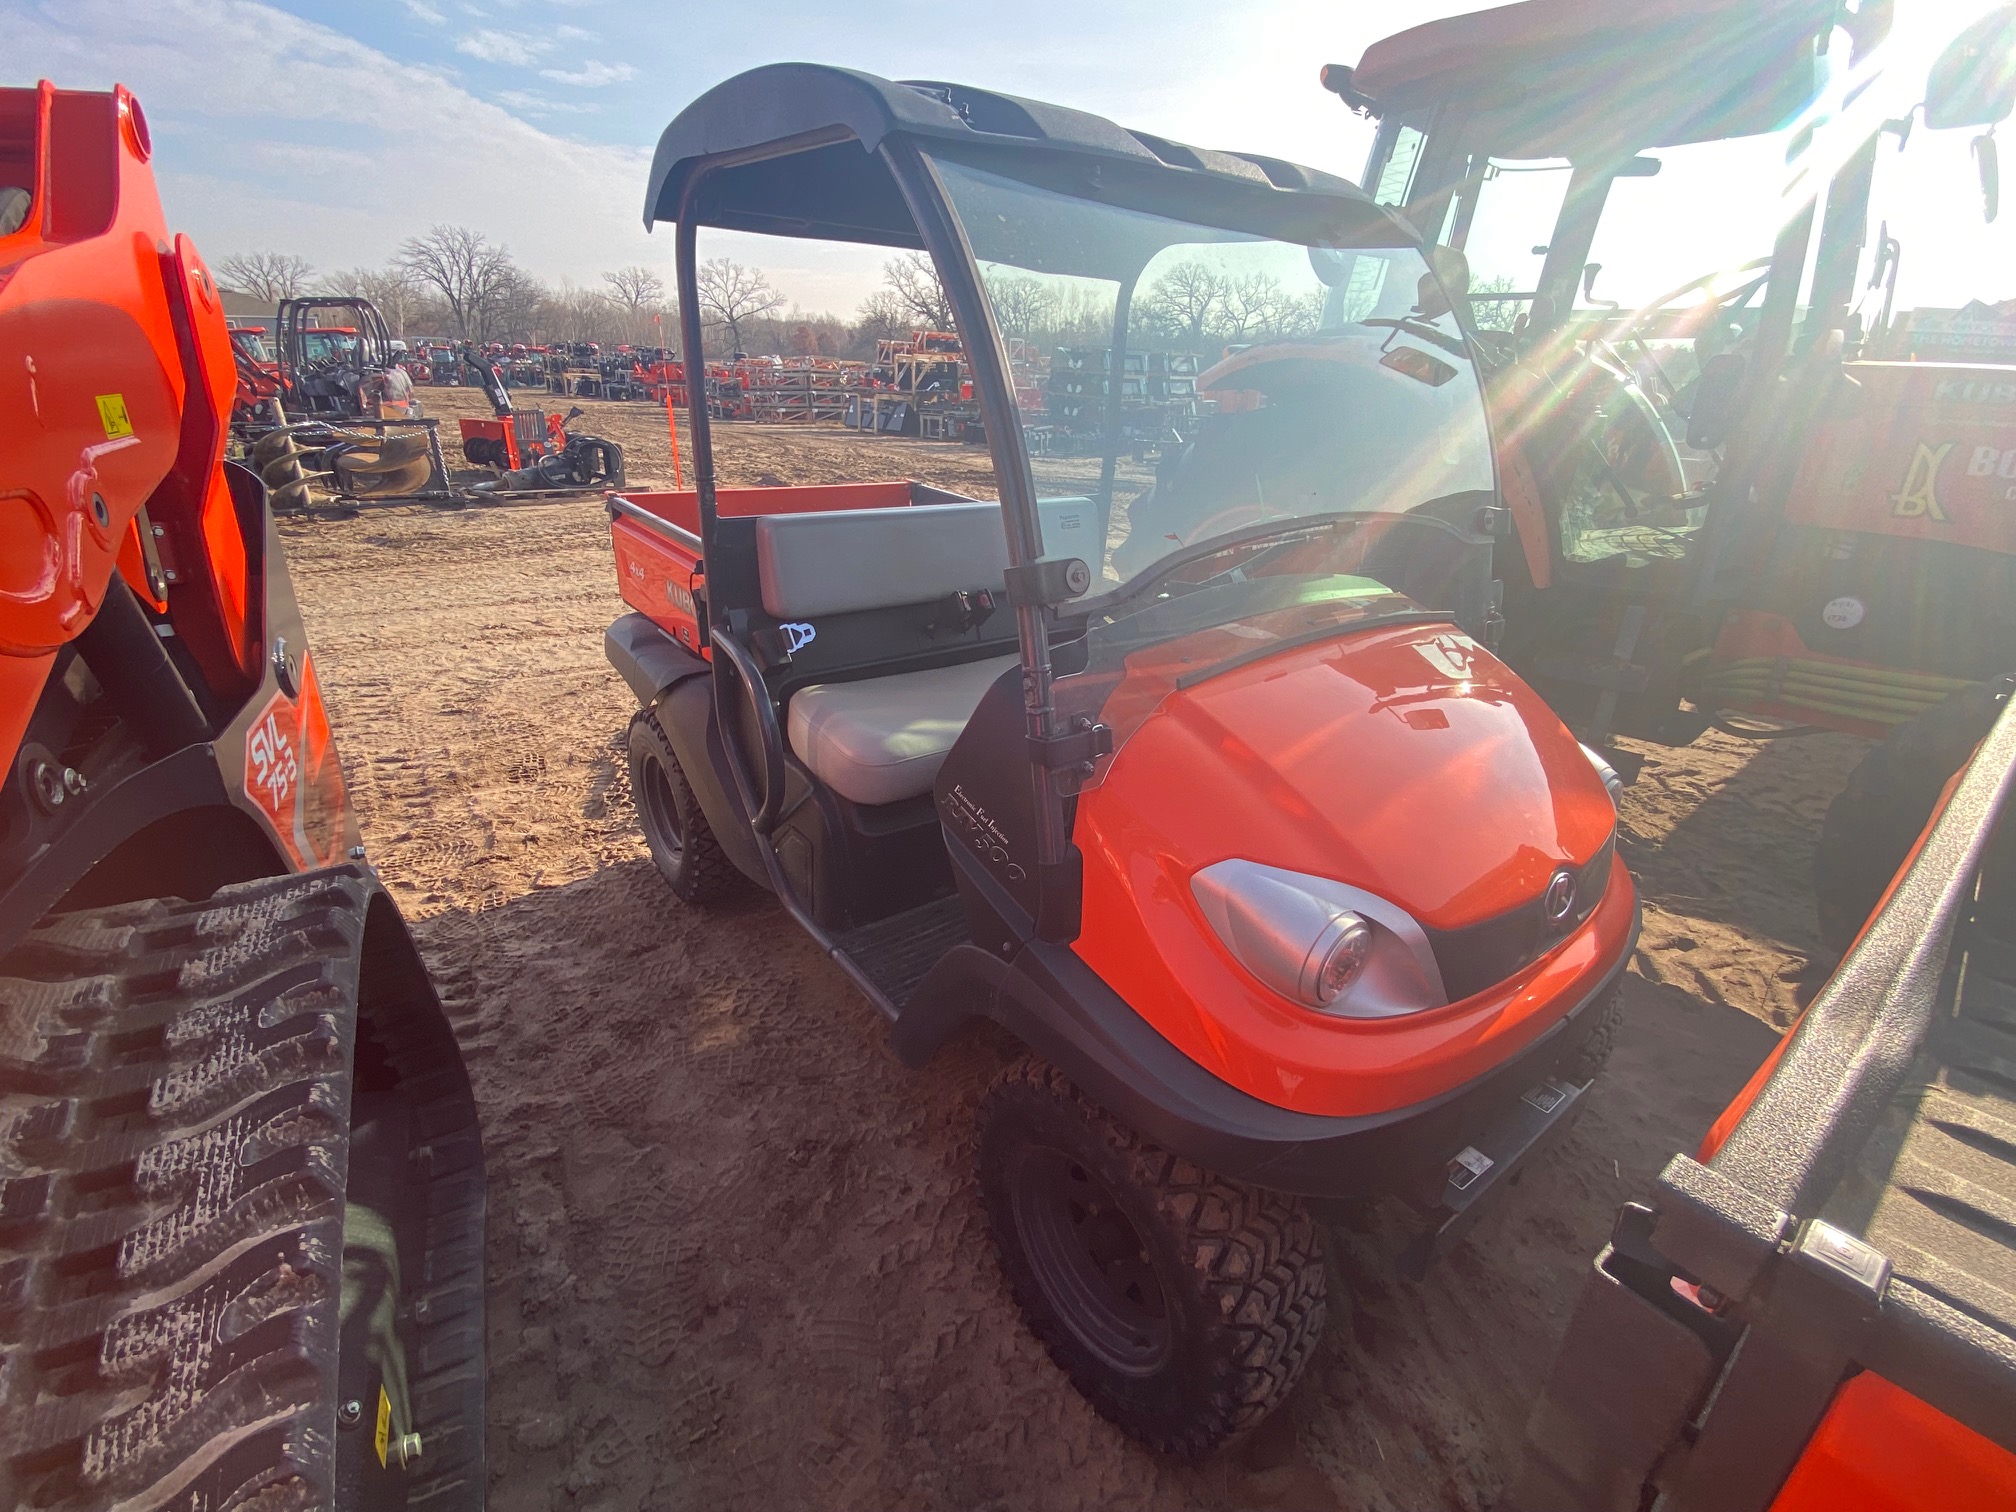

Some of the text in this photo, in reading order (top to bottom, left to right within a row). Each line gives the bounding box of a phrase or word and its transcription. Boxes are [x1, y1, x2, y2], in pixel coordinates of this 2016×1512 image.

[1940, 334, 2016, 347] HOMETOW
[250, 711, 287, 786] SVL
[267, 746, 297, 812] 75-3
[953, 784, 1009, 846] Electronic Fuel Injection
